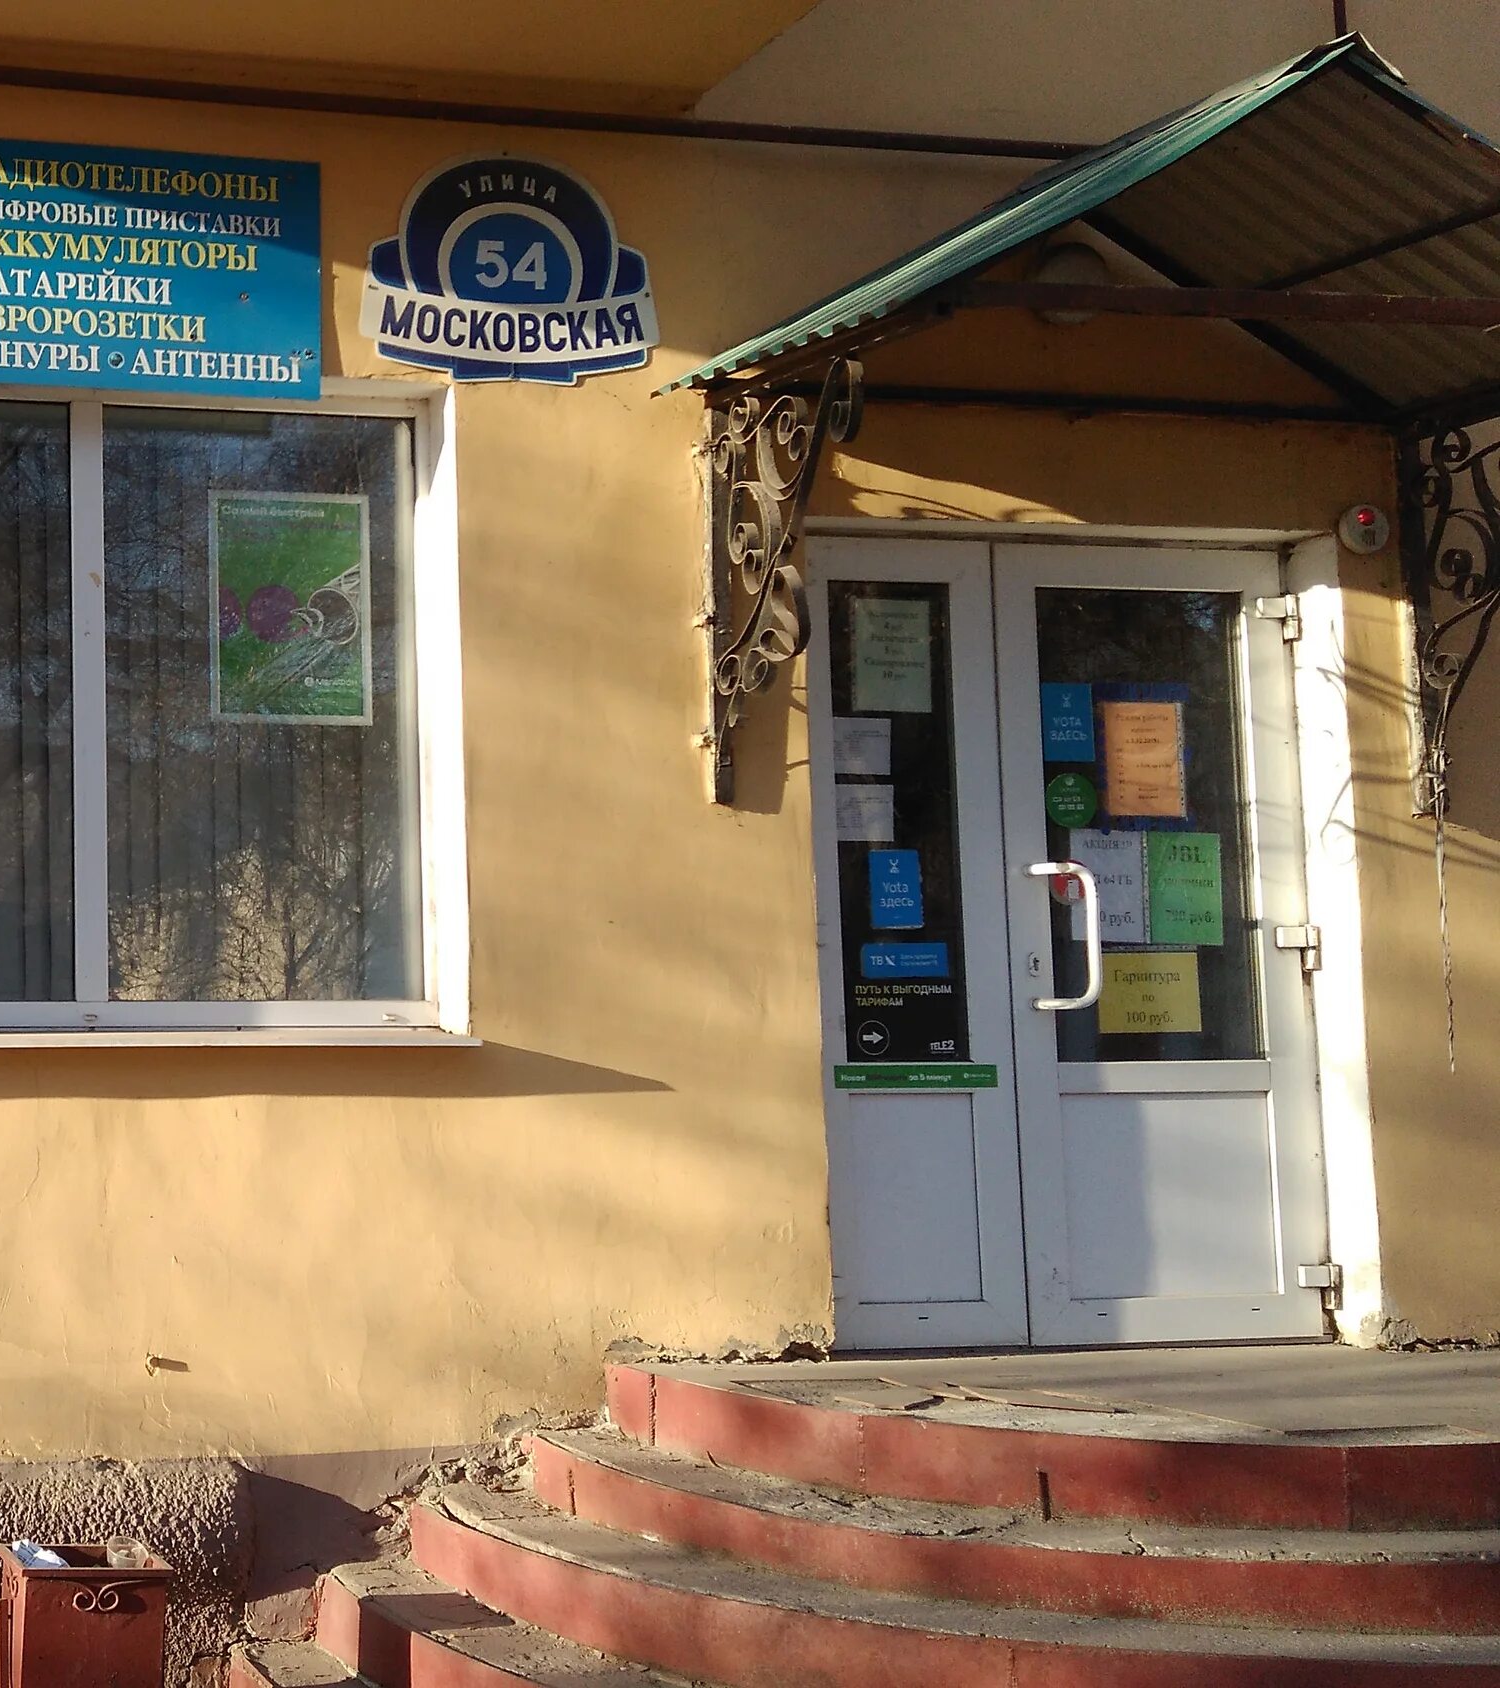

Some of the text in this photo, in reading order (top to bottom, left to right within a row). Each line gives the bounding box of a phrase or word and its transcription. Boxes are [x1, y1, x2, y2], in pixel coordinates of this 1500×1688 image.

[458, 173, 558, 203] УЛИЦА
[126, 207, 281, 238] ПРИСТАВКИ
[475, 240, 548, 290] 54
[380, 295, 645, 353] МОСКОВСКАЯ
[130, 349, 301, 383] АНТЕННЫ
[882, 882, 910, 894] Yota
[880, 896, 915, 909] здесь
[1109, 911, 1135, 927] руб.
[855, 984, 952, 996] ПУТЬ К ВЫГОДНЫМ
[1141, 993, 1155, 1002] по
[856, 997, 904, 1007] ТАРИФАМ
[1126, 1010, 1174, 1027] 100 руб.
[929, 1039, 955, 1051] TELE2
